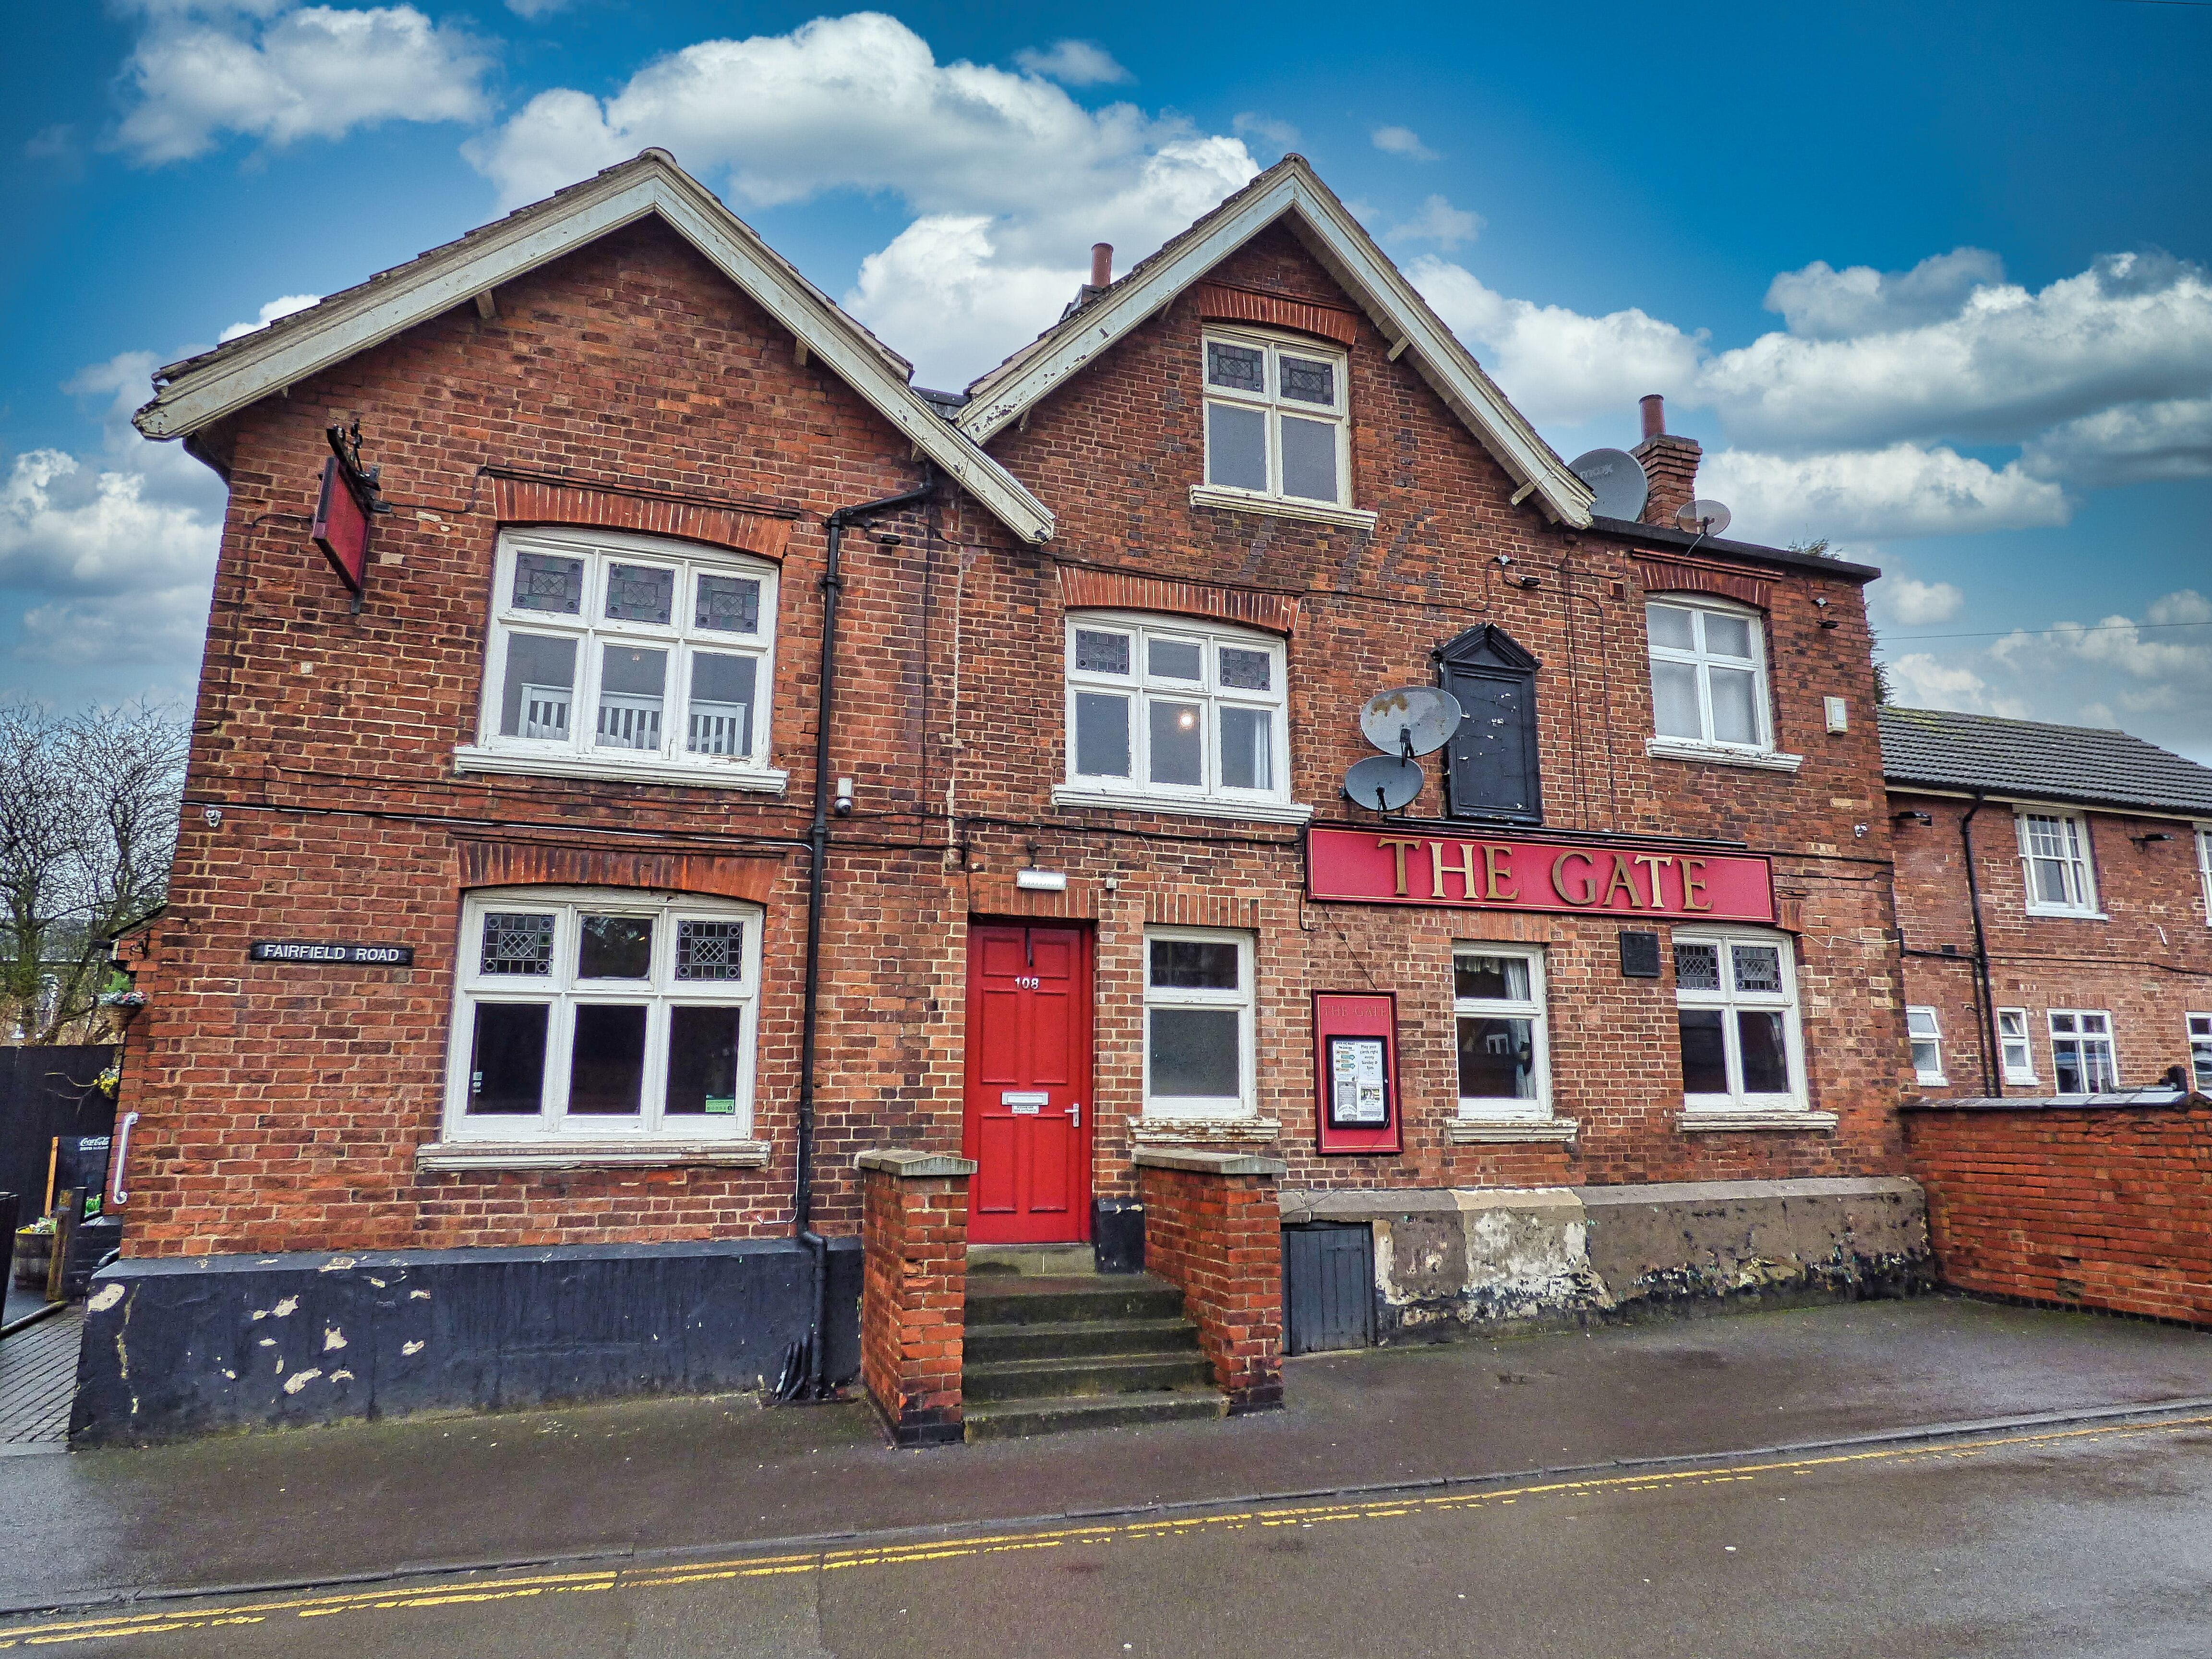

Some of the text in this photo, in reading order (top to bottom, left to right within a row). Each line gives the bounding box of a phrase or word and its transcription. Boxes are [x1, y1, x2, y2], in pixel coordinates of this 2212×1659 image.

[1377, 837, 1714, 911] THE GATE
[264, 944, 399, 962] FAIRFIELD ROAD
[1014, 977, 1039, 989] 108
